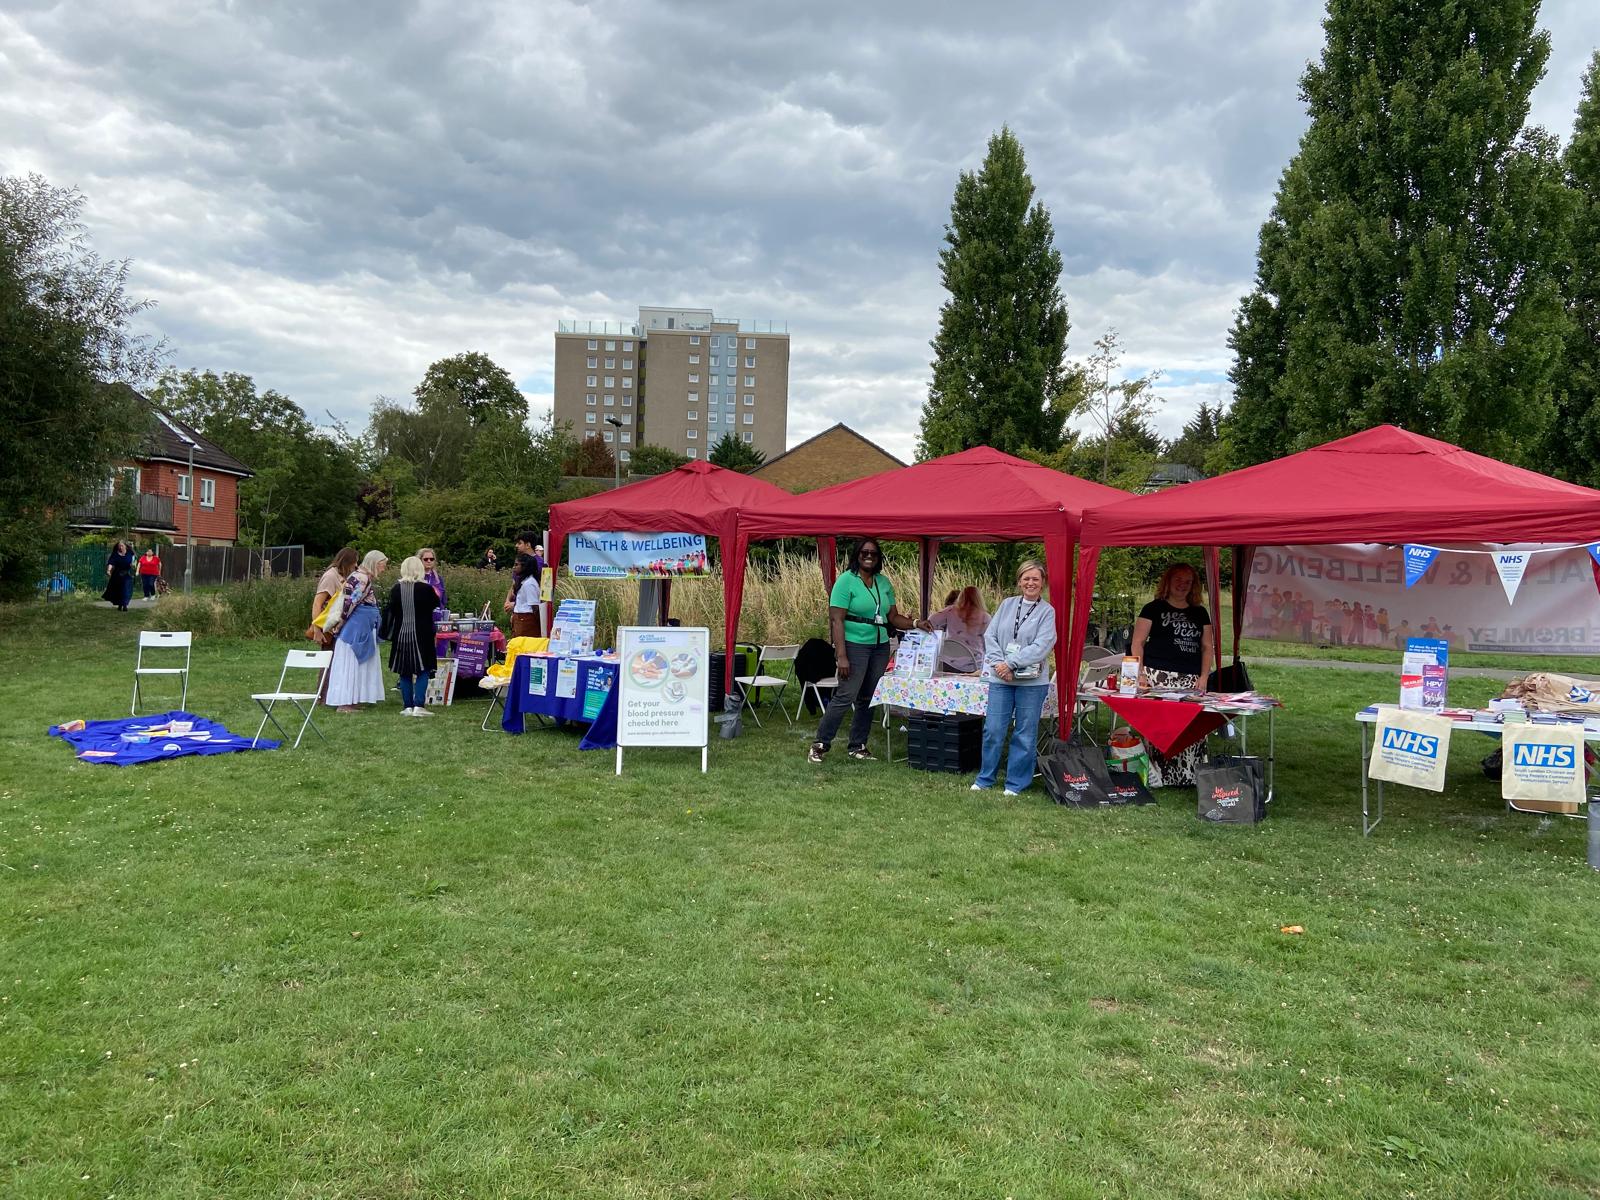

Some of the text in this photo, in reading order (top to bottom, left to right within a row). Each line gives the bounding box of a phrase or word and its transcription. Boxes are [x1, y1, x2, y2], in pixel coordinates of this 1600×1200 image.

[620, 539, 629, 551] &
[632, 534, 702, 551] WELLBEING
[1408, 547, 1432, 558] NHS
[1500, 555, 1523, 564] NHS
[574, 565, 591, 573] ONE
[1161, 611, 1188, 627] yes
[1172, 620, 1198, 635] you
[651, 710, 684, 718] pressure
[627, 719, 660, 727] checked
[1383, 730, 1437, 755] NHS
[1516, 746, 1572, 766] NHS
